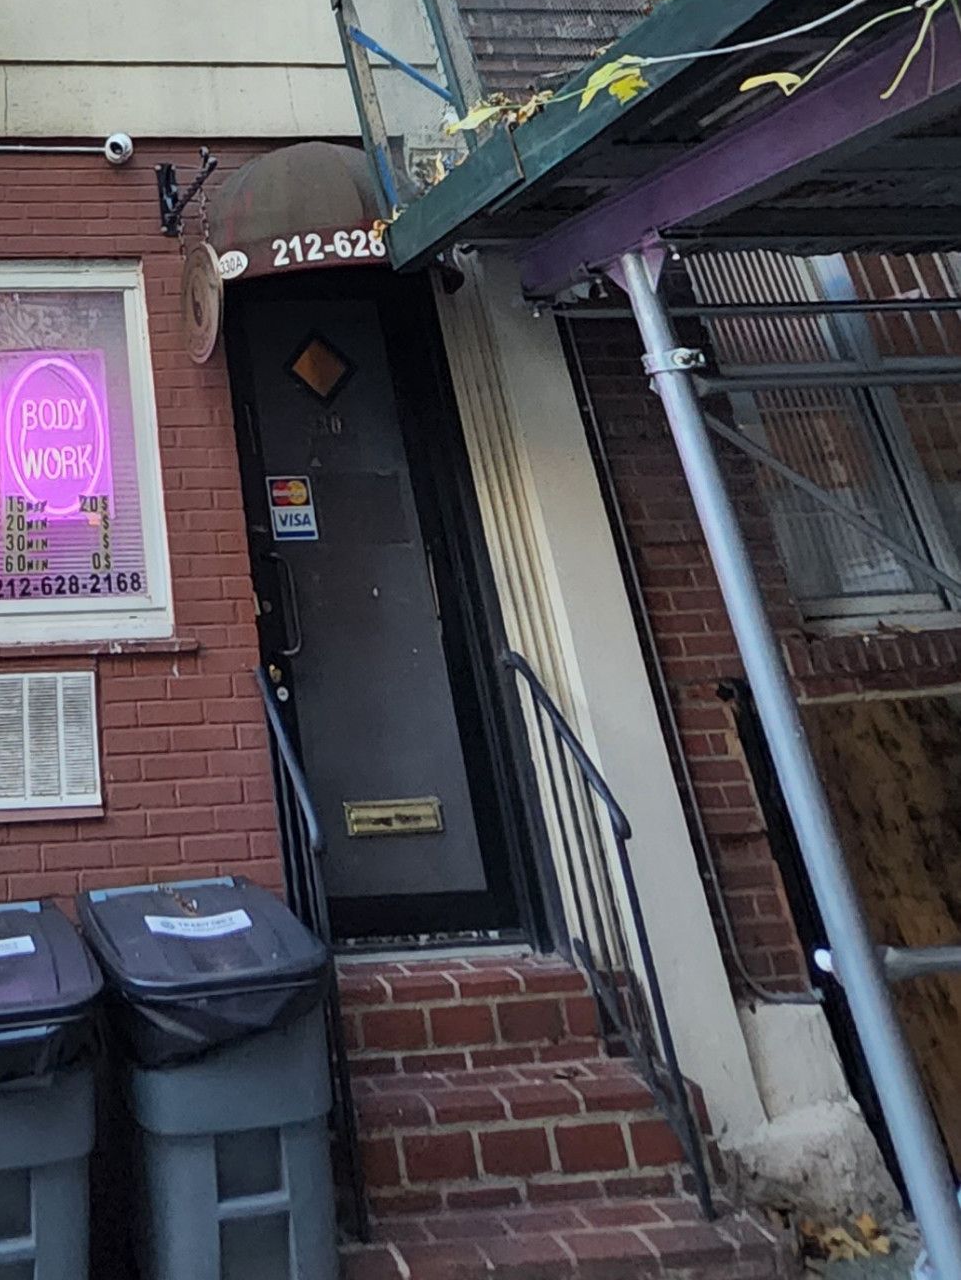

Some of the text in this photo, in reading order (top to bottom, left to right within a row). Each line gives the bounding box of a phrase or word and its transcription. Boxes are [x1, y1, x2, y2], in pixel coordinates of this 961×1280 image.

[22, 398, 87, 431] BODY
[20, 443, 93, 481] WORK
[279, 513, 312, 527] VISA
